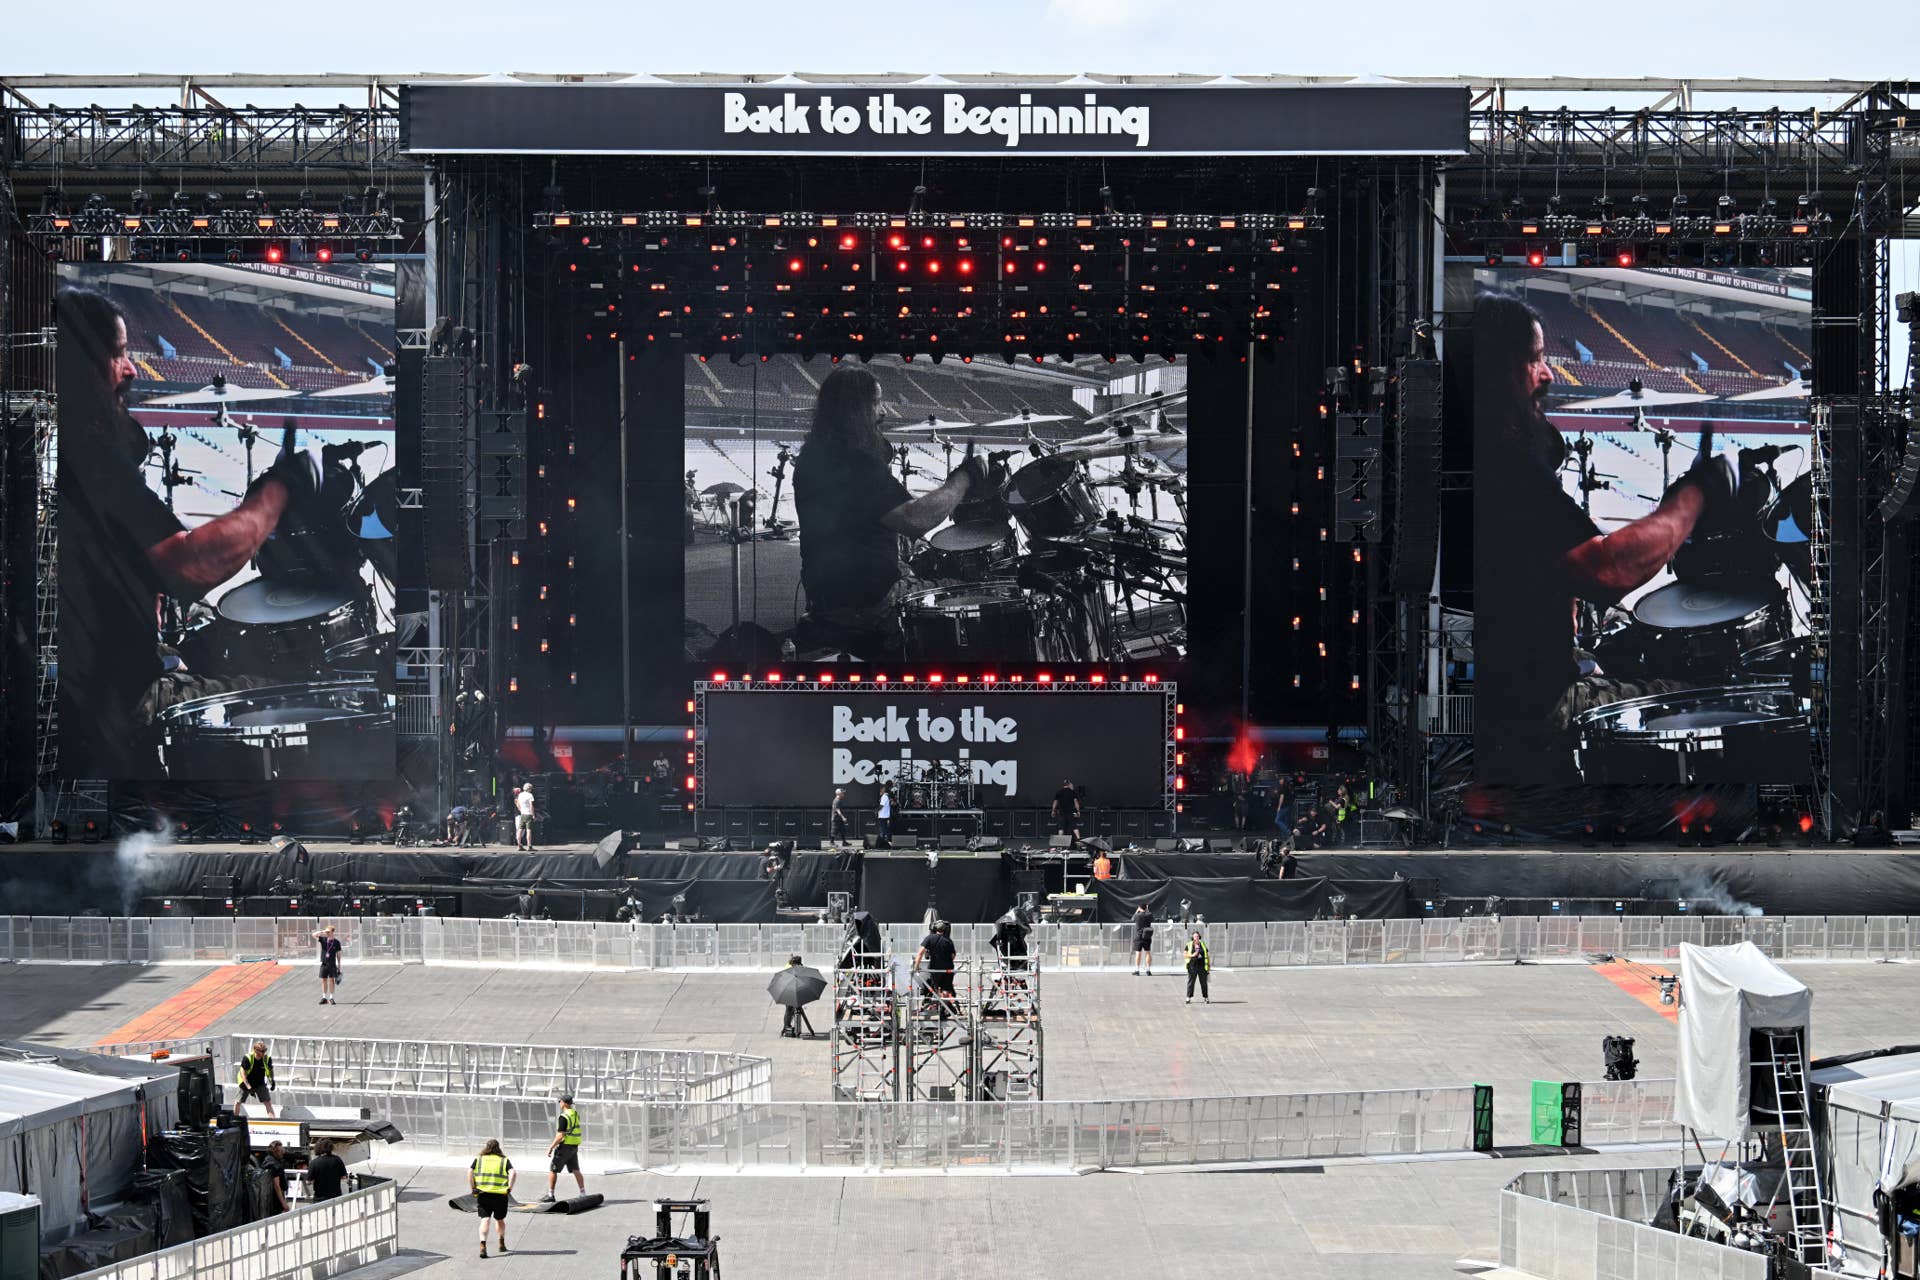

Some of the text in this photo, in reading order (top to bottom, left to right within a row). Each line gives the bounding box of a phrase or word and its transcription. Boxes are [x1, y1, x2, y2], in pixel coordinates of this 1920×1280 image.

[724, 92, 1151, 147] Back to the Beginning
[261, 263, 279, 275] MUST
[324, 275, 340, 286] PETER
[1678, 268, 1696, 278] MUST
[1740, 280, 1757, 290] PETER
[833, 706, 1017, 742] Back to the
